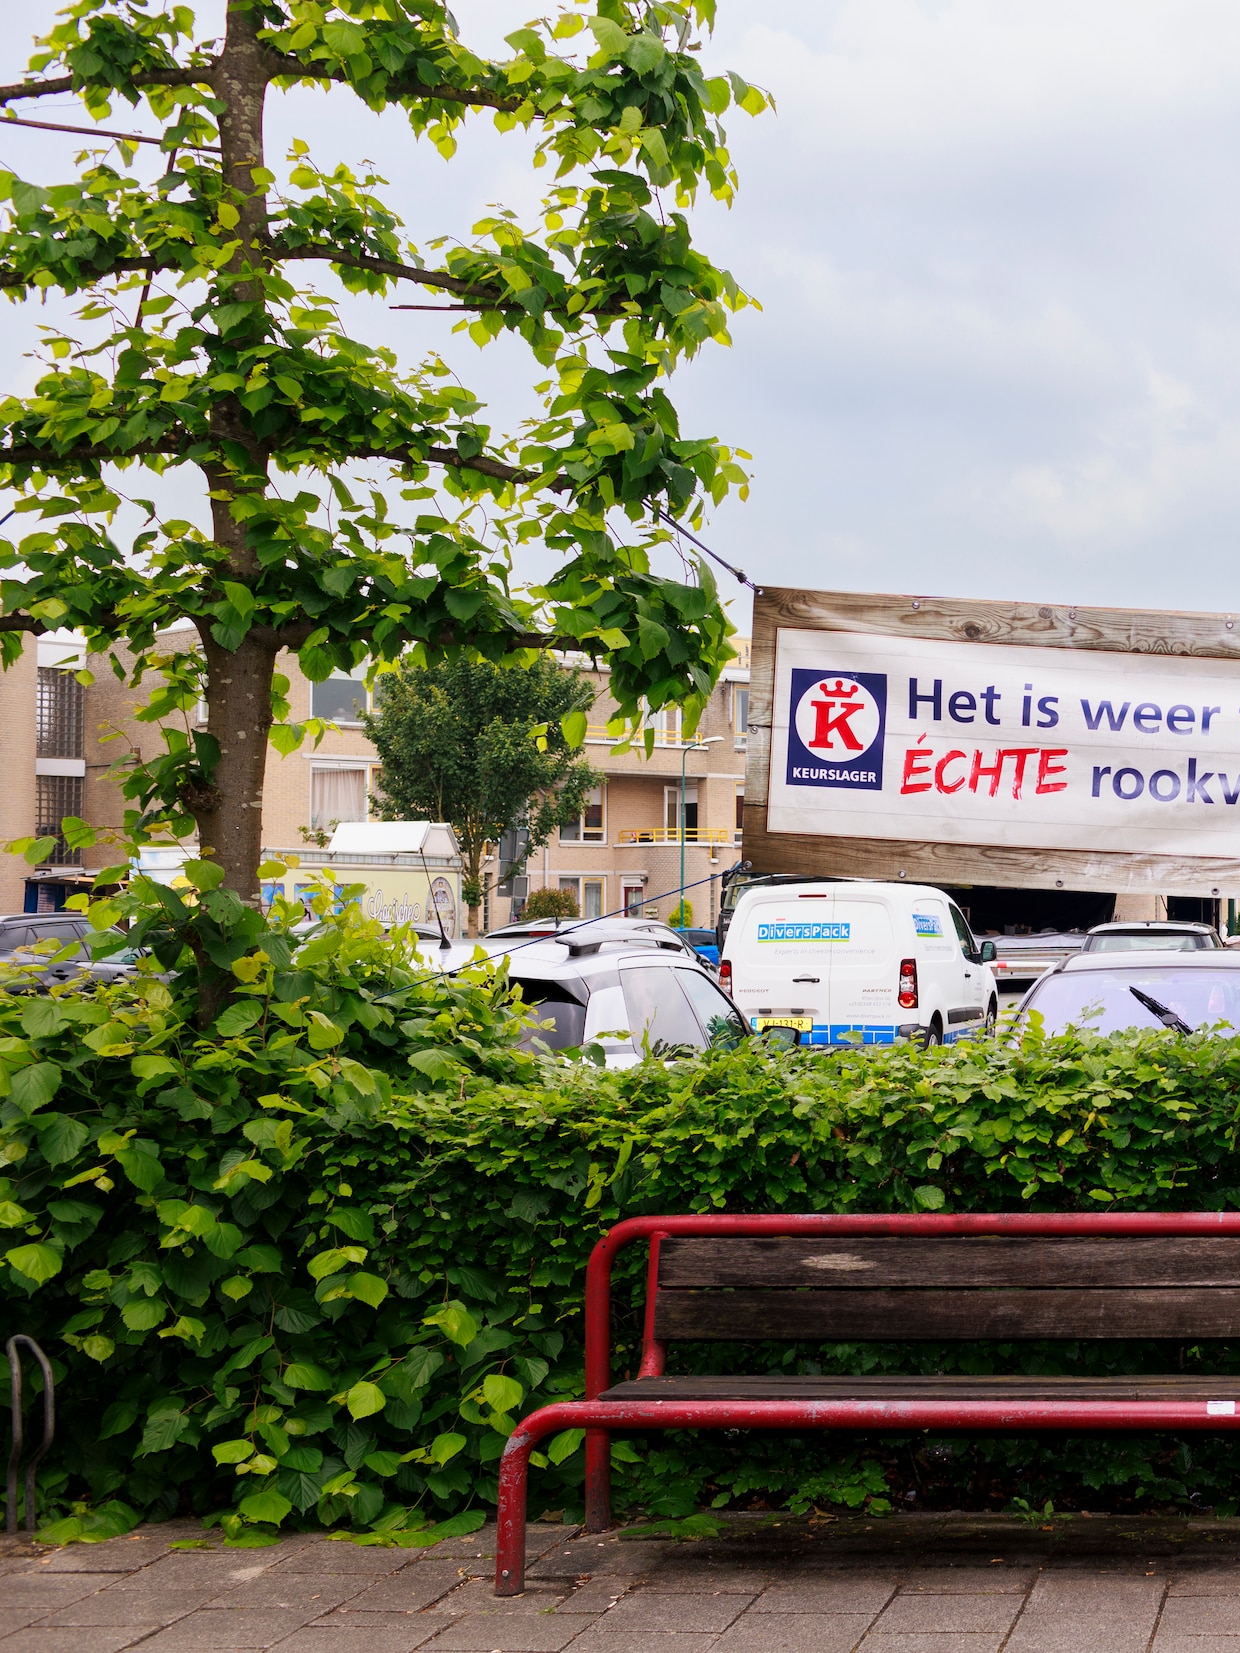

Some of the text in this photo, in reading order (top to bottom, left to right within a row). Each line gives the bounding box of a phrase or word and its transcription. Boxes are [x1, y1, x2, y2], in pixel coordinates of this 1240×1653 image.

[808, 699, 864, 751] K
[909, 677, 1001, 726] Het
[1021, 683, 1059, 729] is
[1080, 698, 1221, 736] weer
[792, 767, 877, 783] KEURSLAGER
[900, 732, 1068, 800] ÉCHTE
[758, 923, 849, 939] DiversPack
